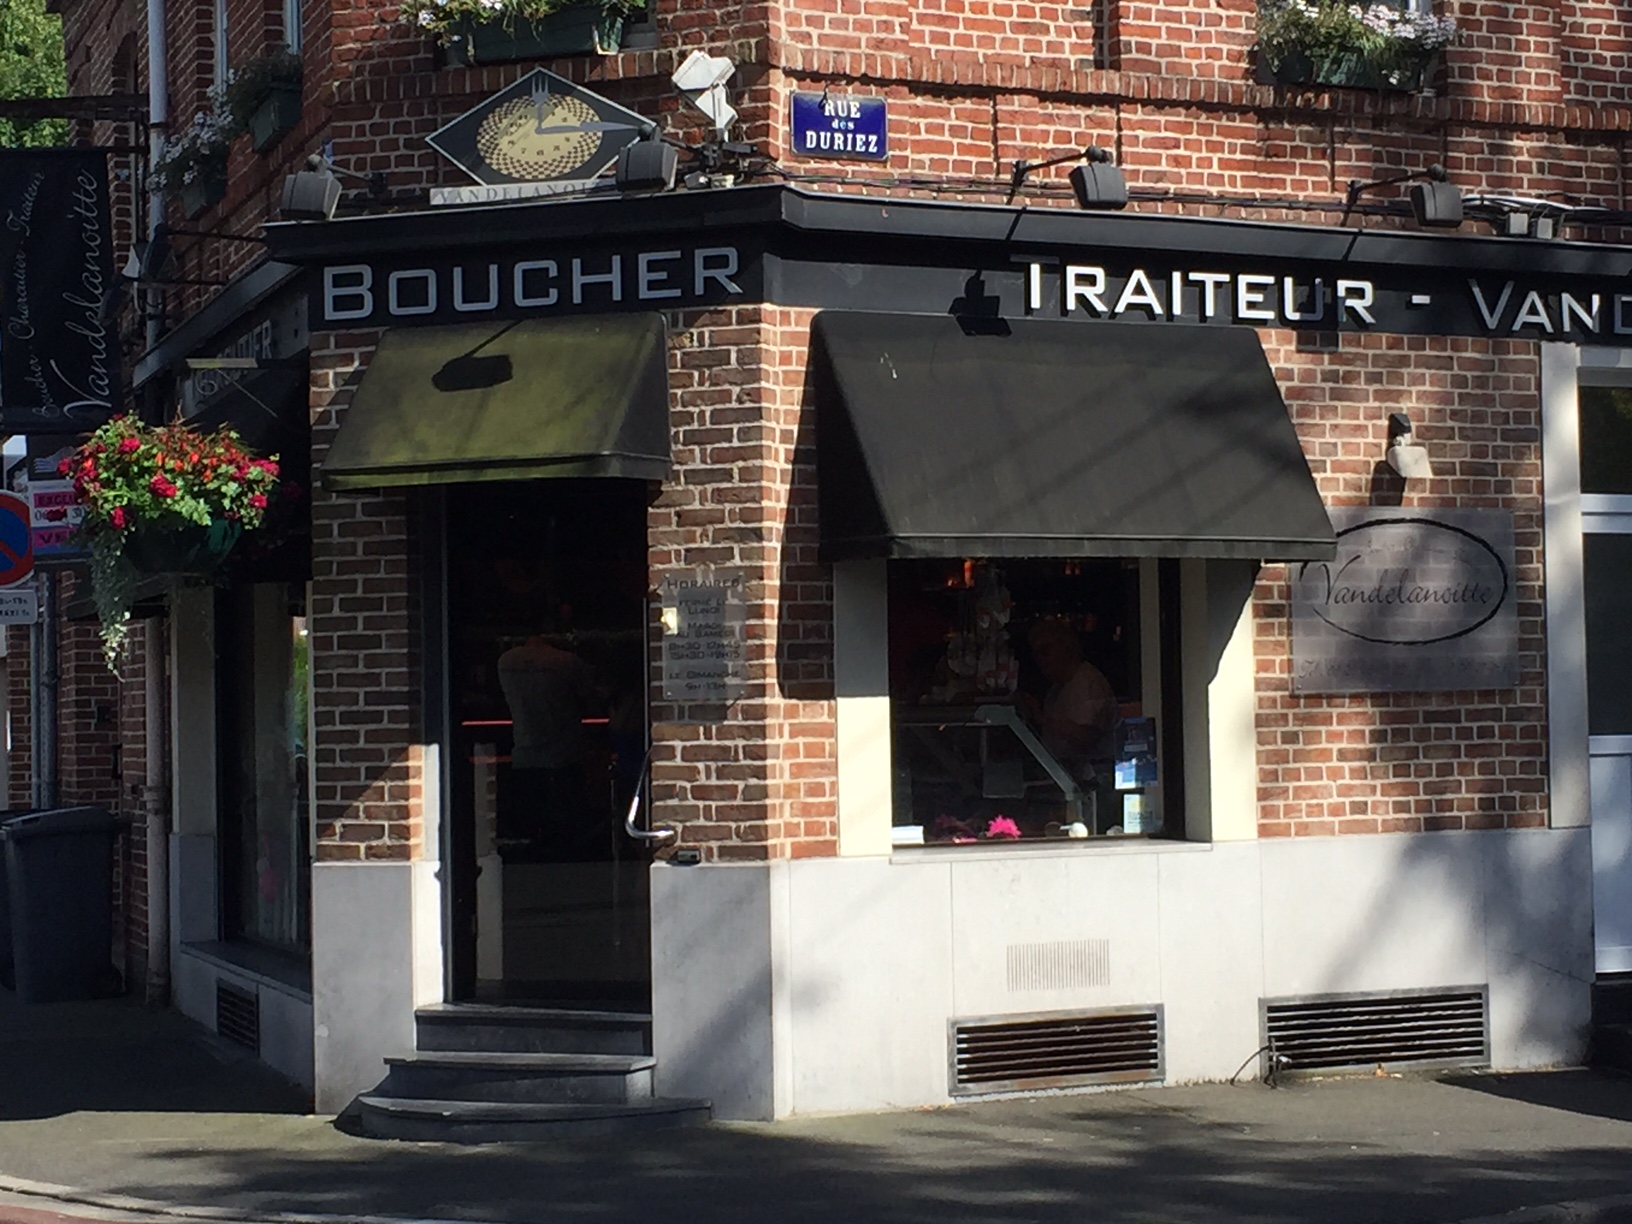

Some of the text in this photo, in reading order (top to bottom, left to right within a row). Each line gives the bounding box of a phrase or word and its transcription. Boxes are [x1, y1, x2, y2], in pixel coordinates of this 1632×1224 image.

[823, 100, 861, 118] RUE
[831, 119, 855, 130] des
[805, 131, 878, 153] DURIEZ
[50, 168, 113, 418] Vandelanoitte
[323, 246, 744, 321] BOUCHER
[667, 579, 741, 589] HORAIRES
[1319, 553, 1493, 606] Vandelanoitte
